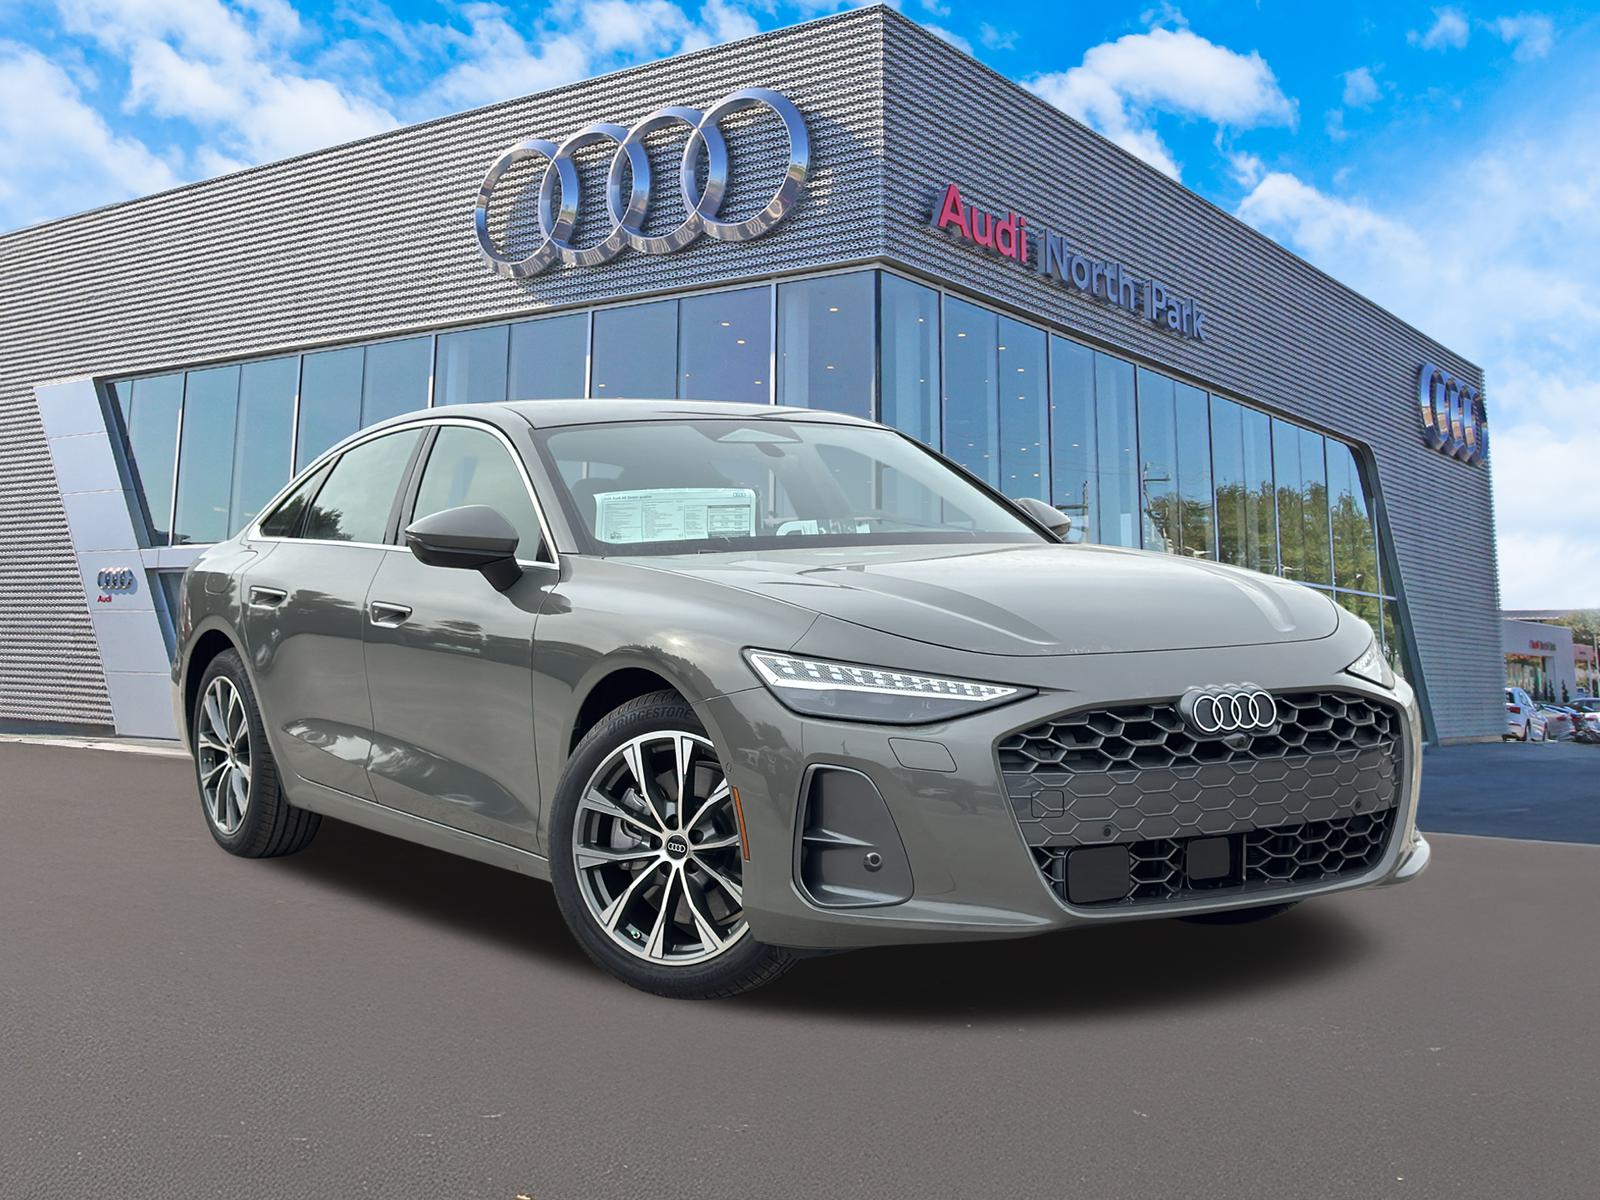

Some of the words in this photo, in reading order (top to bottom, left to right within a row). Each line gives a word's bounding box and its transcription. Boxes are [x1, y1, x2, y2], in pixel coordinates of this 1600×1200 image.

[935, 183, 1027, 263] Audi
[1042, 229, 1138, 311] North
[1147, 279, 1207, 341] Park
